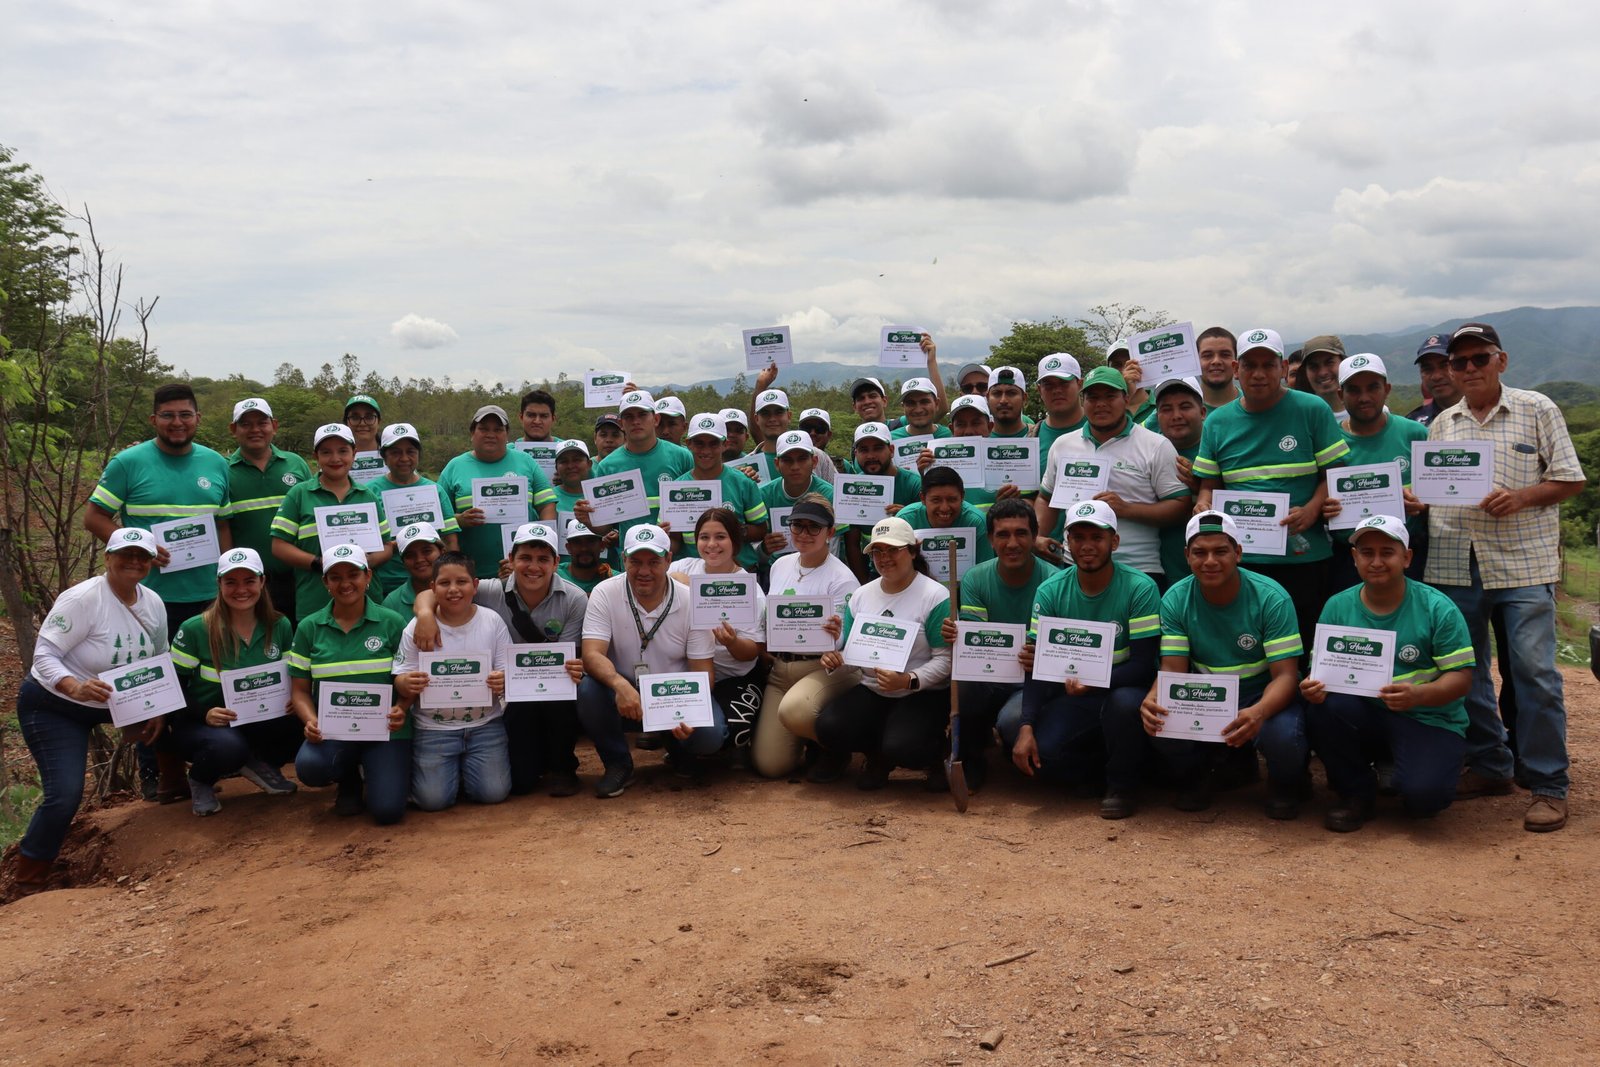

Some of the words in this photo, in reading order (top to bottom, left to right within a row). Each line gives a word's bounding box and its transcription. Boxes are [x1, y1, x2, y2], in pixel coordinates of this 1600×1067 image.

[1357, 478, 1381, 487] Huella
[1070, 634, 1093, 643] Huella
[1349, 642, 1374, 651] Huella
[1192, 689, 1217, 697] Huella
[728, 684, 763, 724] Klein
